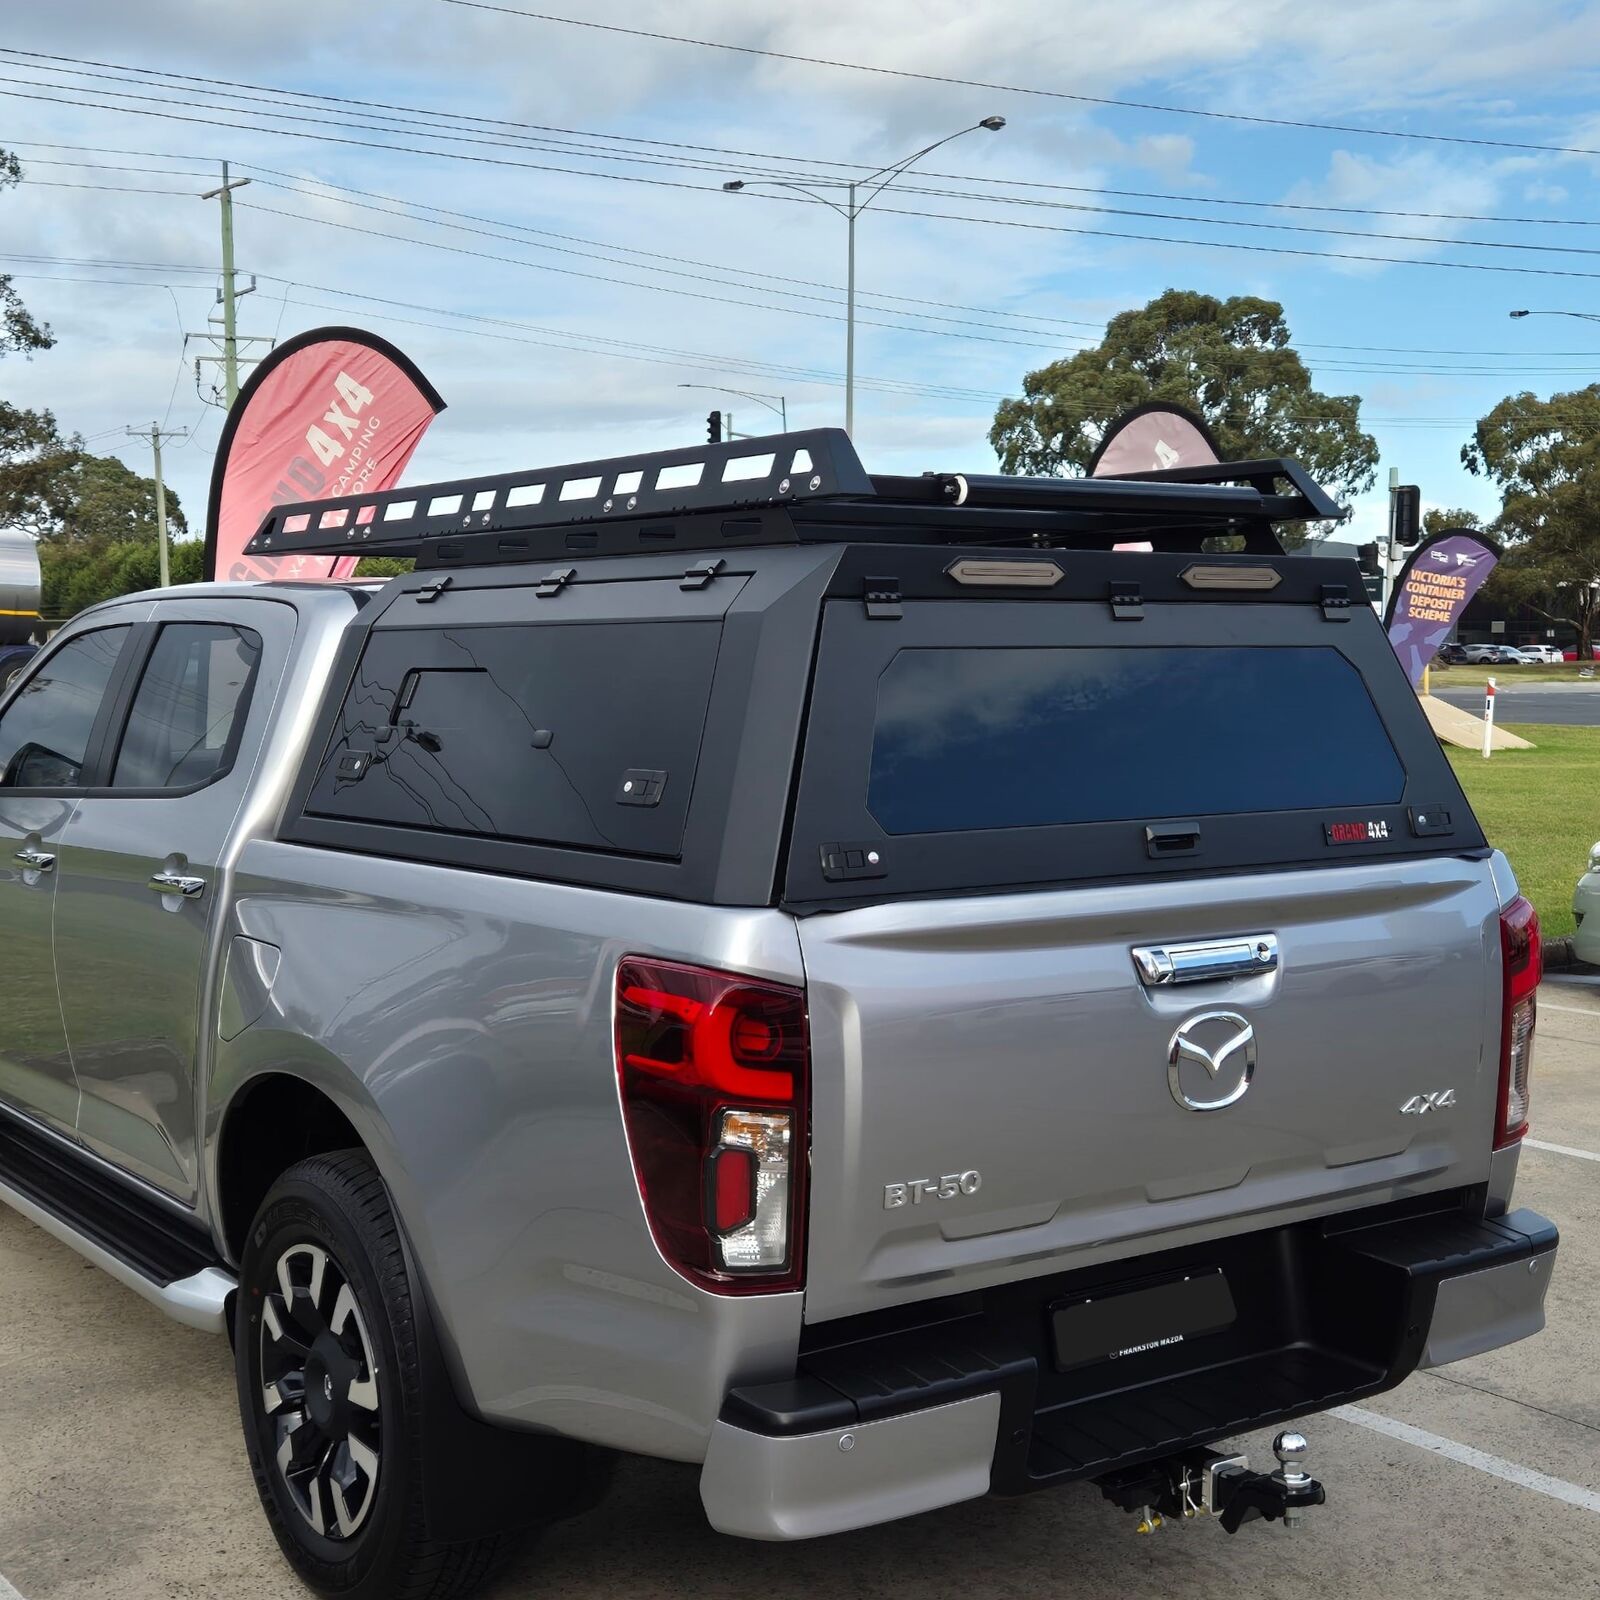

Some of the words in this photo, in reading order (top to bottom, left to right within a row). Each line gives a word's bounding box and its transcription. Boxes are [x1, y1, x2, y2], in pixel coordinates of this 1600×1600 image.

[332, 416, 380, 497] CAMPING
[1411, 569, 1467, 588] VICTORIA'S
[1406, 581, 1465, 600] CONTAINER
[1410, 594, 1455, 611] DEPOSIT
[1408, 606, 1451, 622] SCHEME
[1331, 822, 1367, 842] GRAND
[883, 1170, 982, 1210] BT-50
[1119, 1340, 1159, 1357] FRANKSTON
[1160, 1334, 1184, 1347] MAZDA
